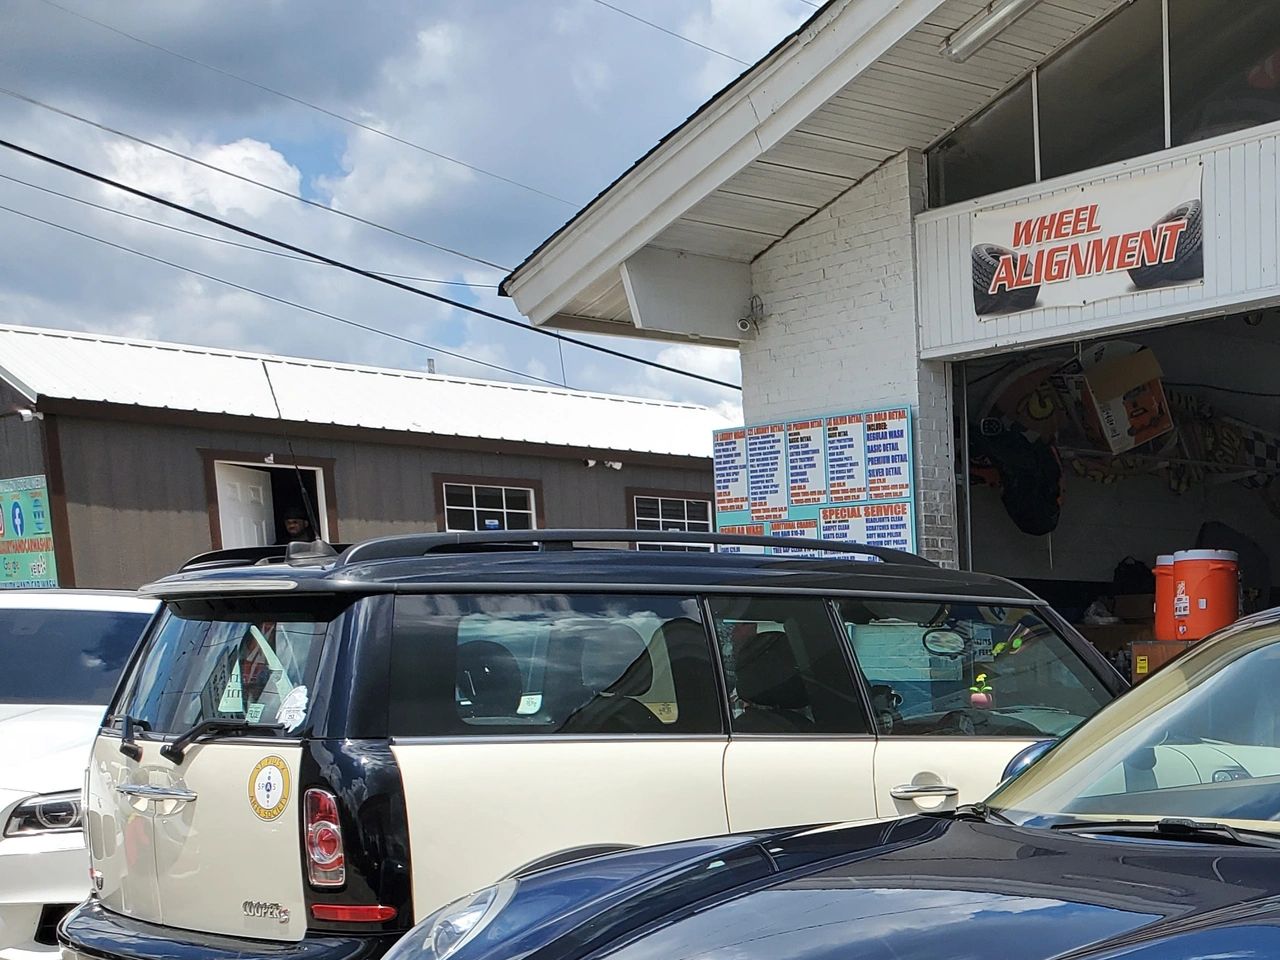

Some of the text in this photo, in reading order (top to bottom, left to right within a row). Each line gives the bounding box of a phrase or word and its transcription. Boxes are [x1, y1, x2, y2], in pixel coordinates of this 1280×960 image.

[1012, 204, 1101, 248] WHEEL
[989, 220, 1187, 294] ALIGNMENT
[883, 443, 899, 452] DETAIL
[885, 467, 902, 476] DETAIL
[822, 504, 907, 520] SPECIAL SERVICE
[243, 901, 281, 918] COOPER
